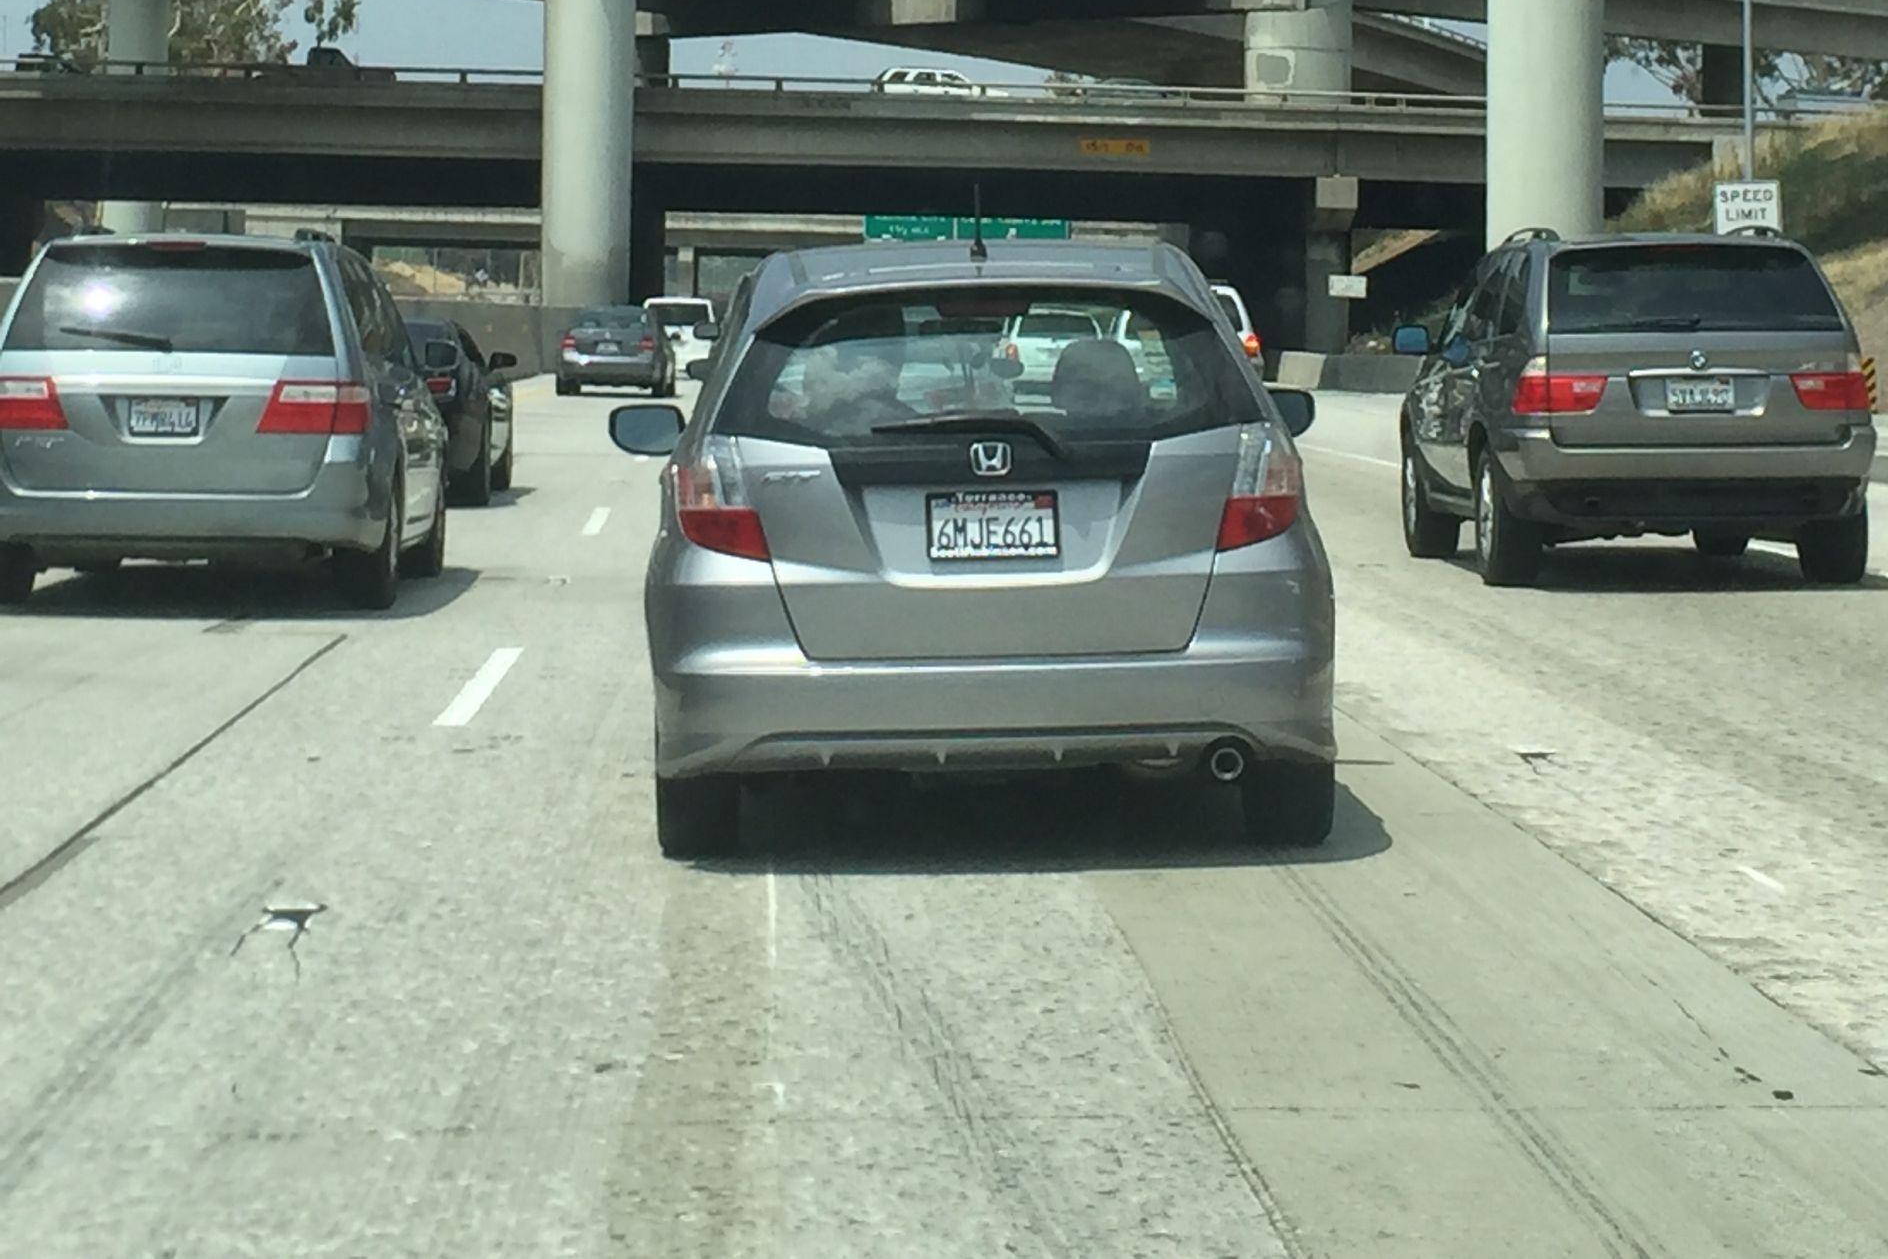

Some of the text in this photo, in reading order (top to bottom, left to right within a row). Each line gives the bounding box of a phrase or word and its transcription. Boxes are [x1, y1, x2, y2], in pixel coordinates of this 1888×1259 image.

[1720, 188, 1773, 203] SPEED
[1725, 207, 1767, 222] LIMIT
[937, 516, 1051, 550] 6MJE661
